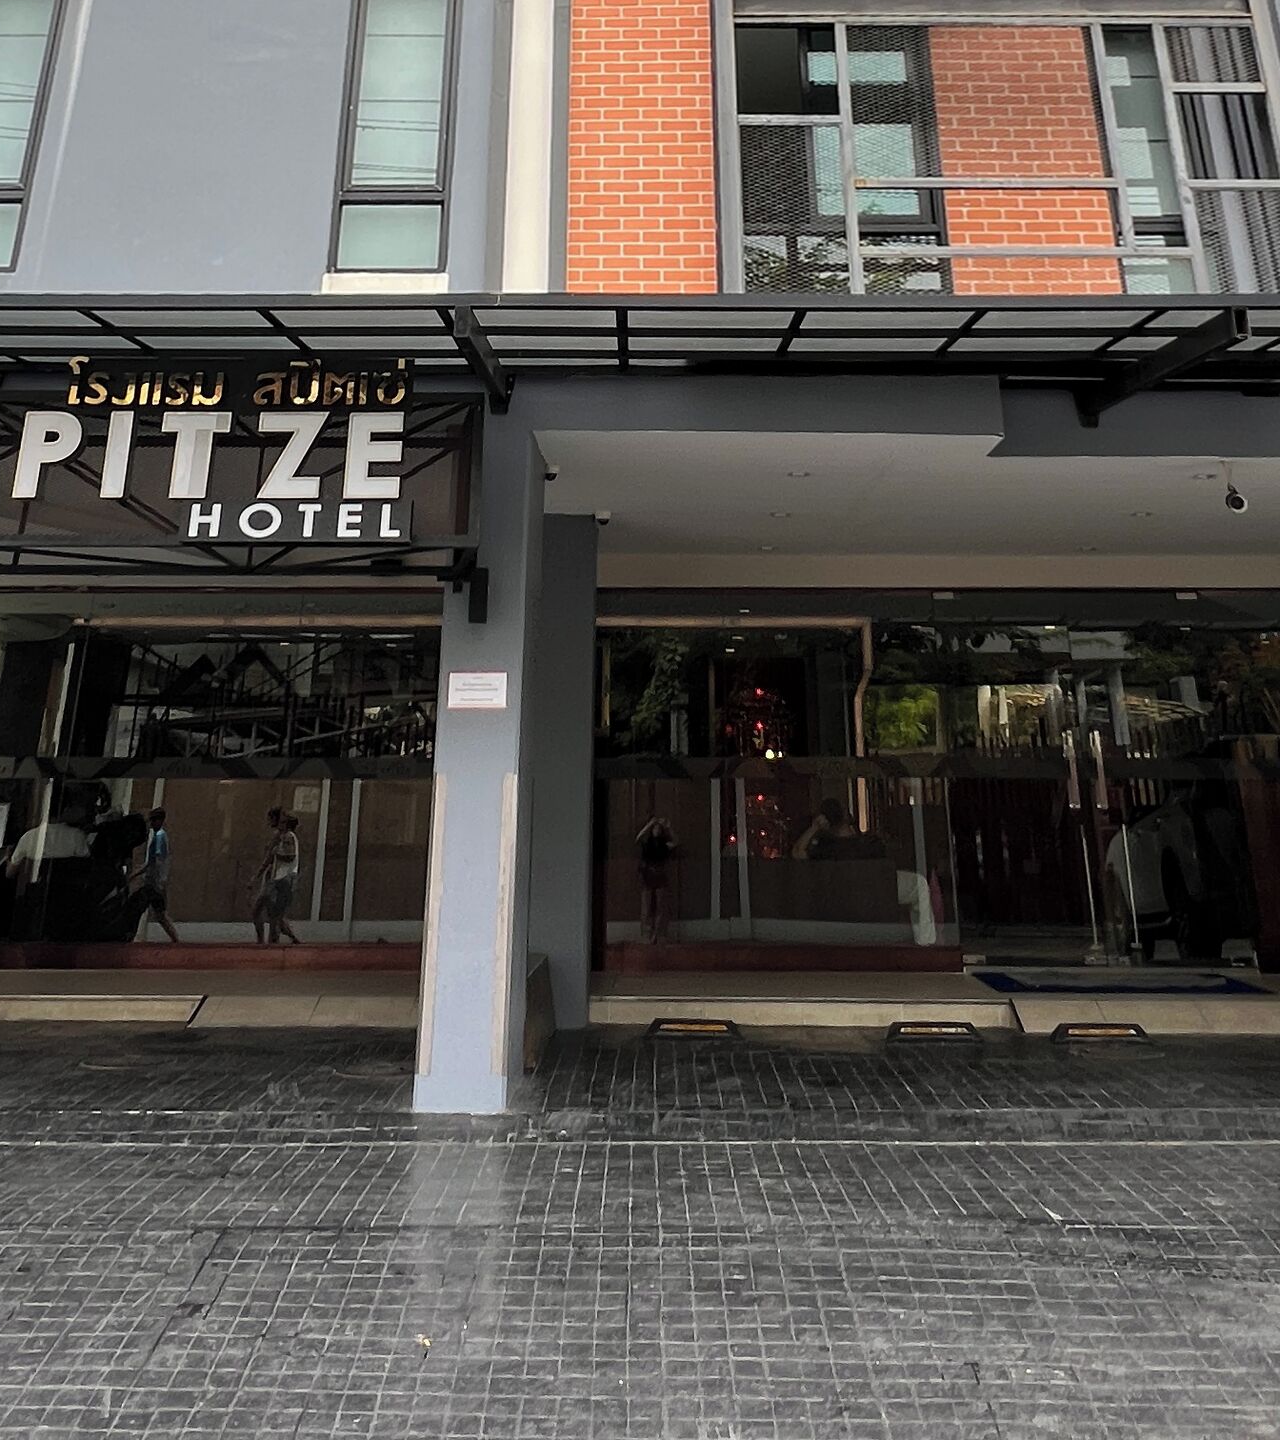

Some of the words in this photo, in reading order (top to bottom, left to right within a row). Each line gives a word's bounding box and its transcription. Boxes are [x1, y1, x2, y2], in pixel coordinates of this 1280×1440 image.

[67, 356, 224, 406] โรงแรม
[187, 502, 402, 538] HOTEL
